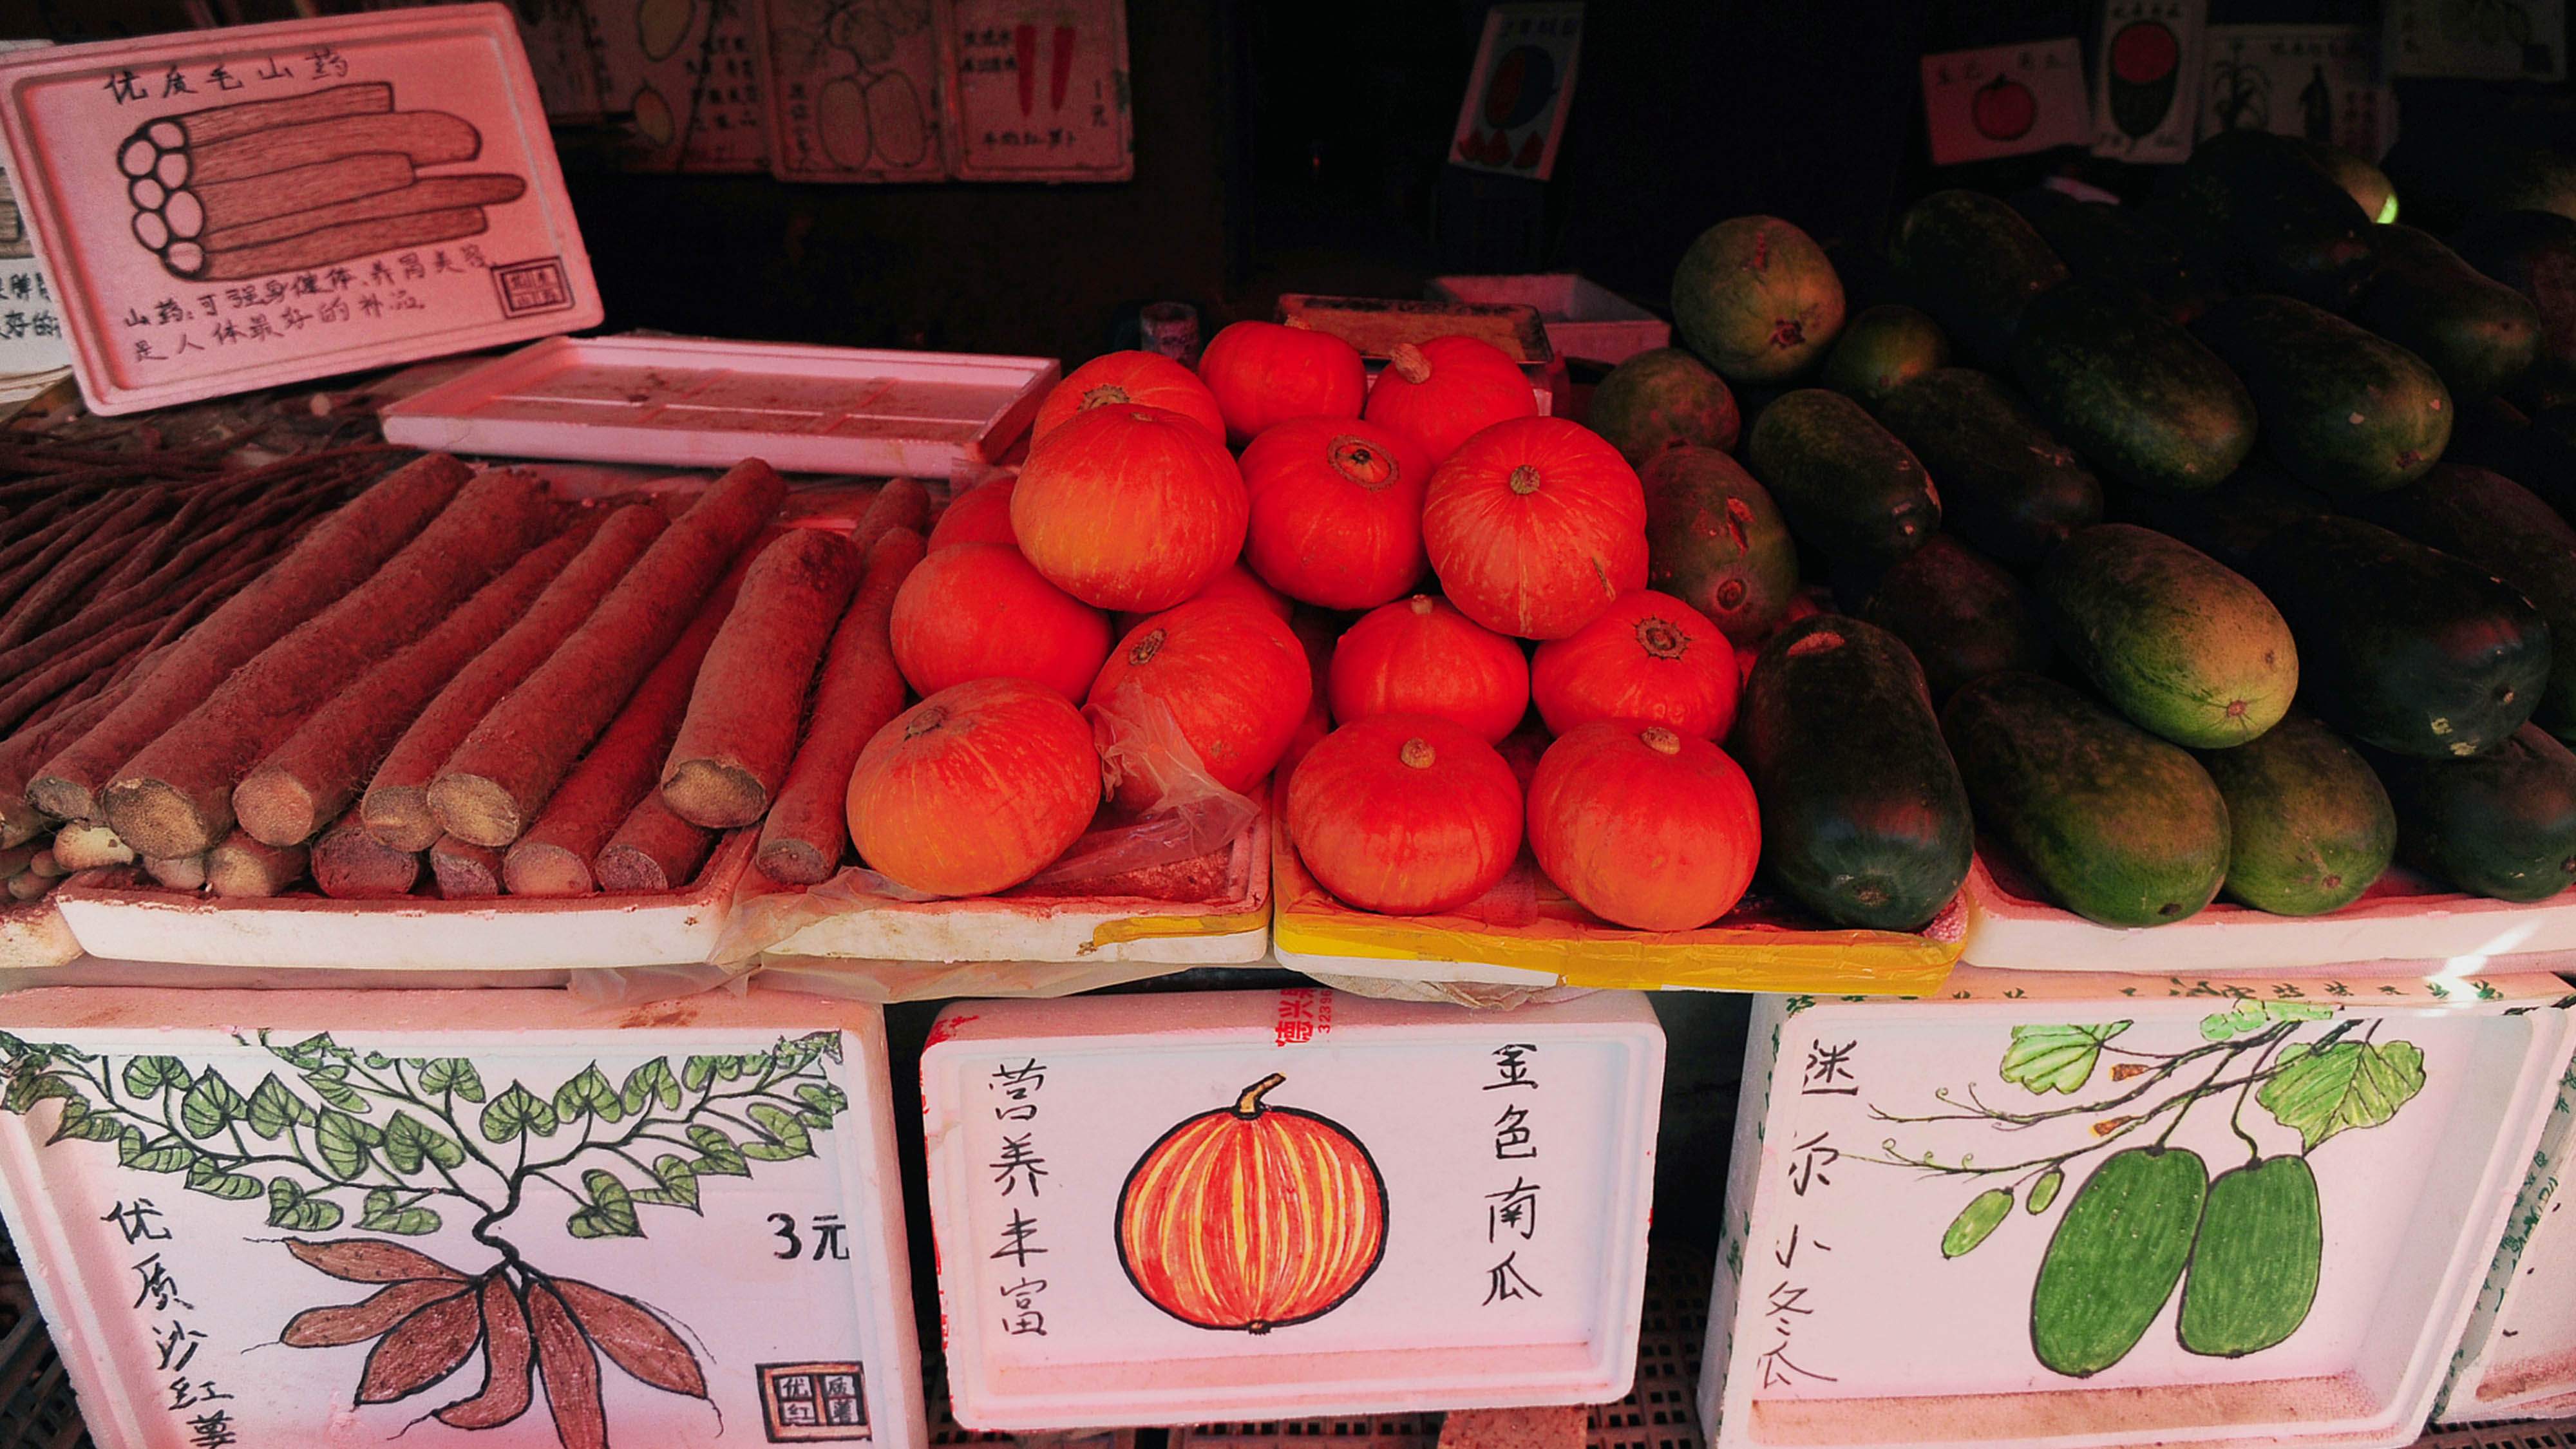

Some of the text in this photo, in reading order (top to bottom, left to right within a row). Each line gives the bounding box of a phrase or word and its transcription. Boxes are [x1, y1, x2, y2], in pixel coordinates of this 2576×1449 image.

[103, 48, 348, 105] 优质毛山药
[767, 1213, 851, 1261] 3元
[989, 1057, 1049, 1338] 营养丰富
[1481, 1043, 1542, 1308] 金色南瓜
[1756, 1038, 1859, 1389] 迷尔小冬瓜
[782, 1376, 848, 1397] 优质
